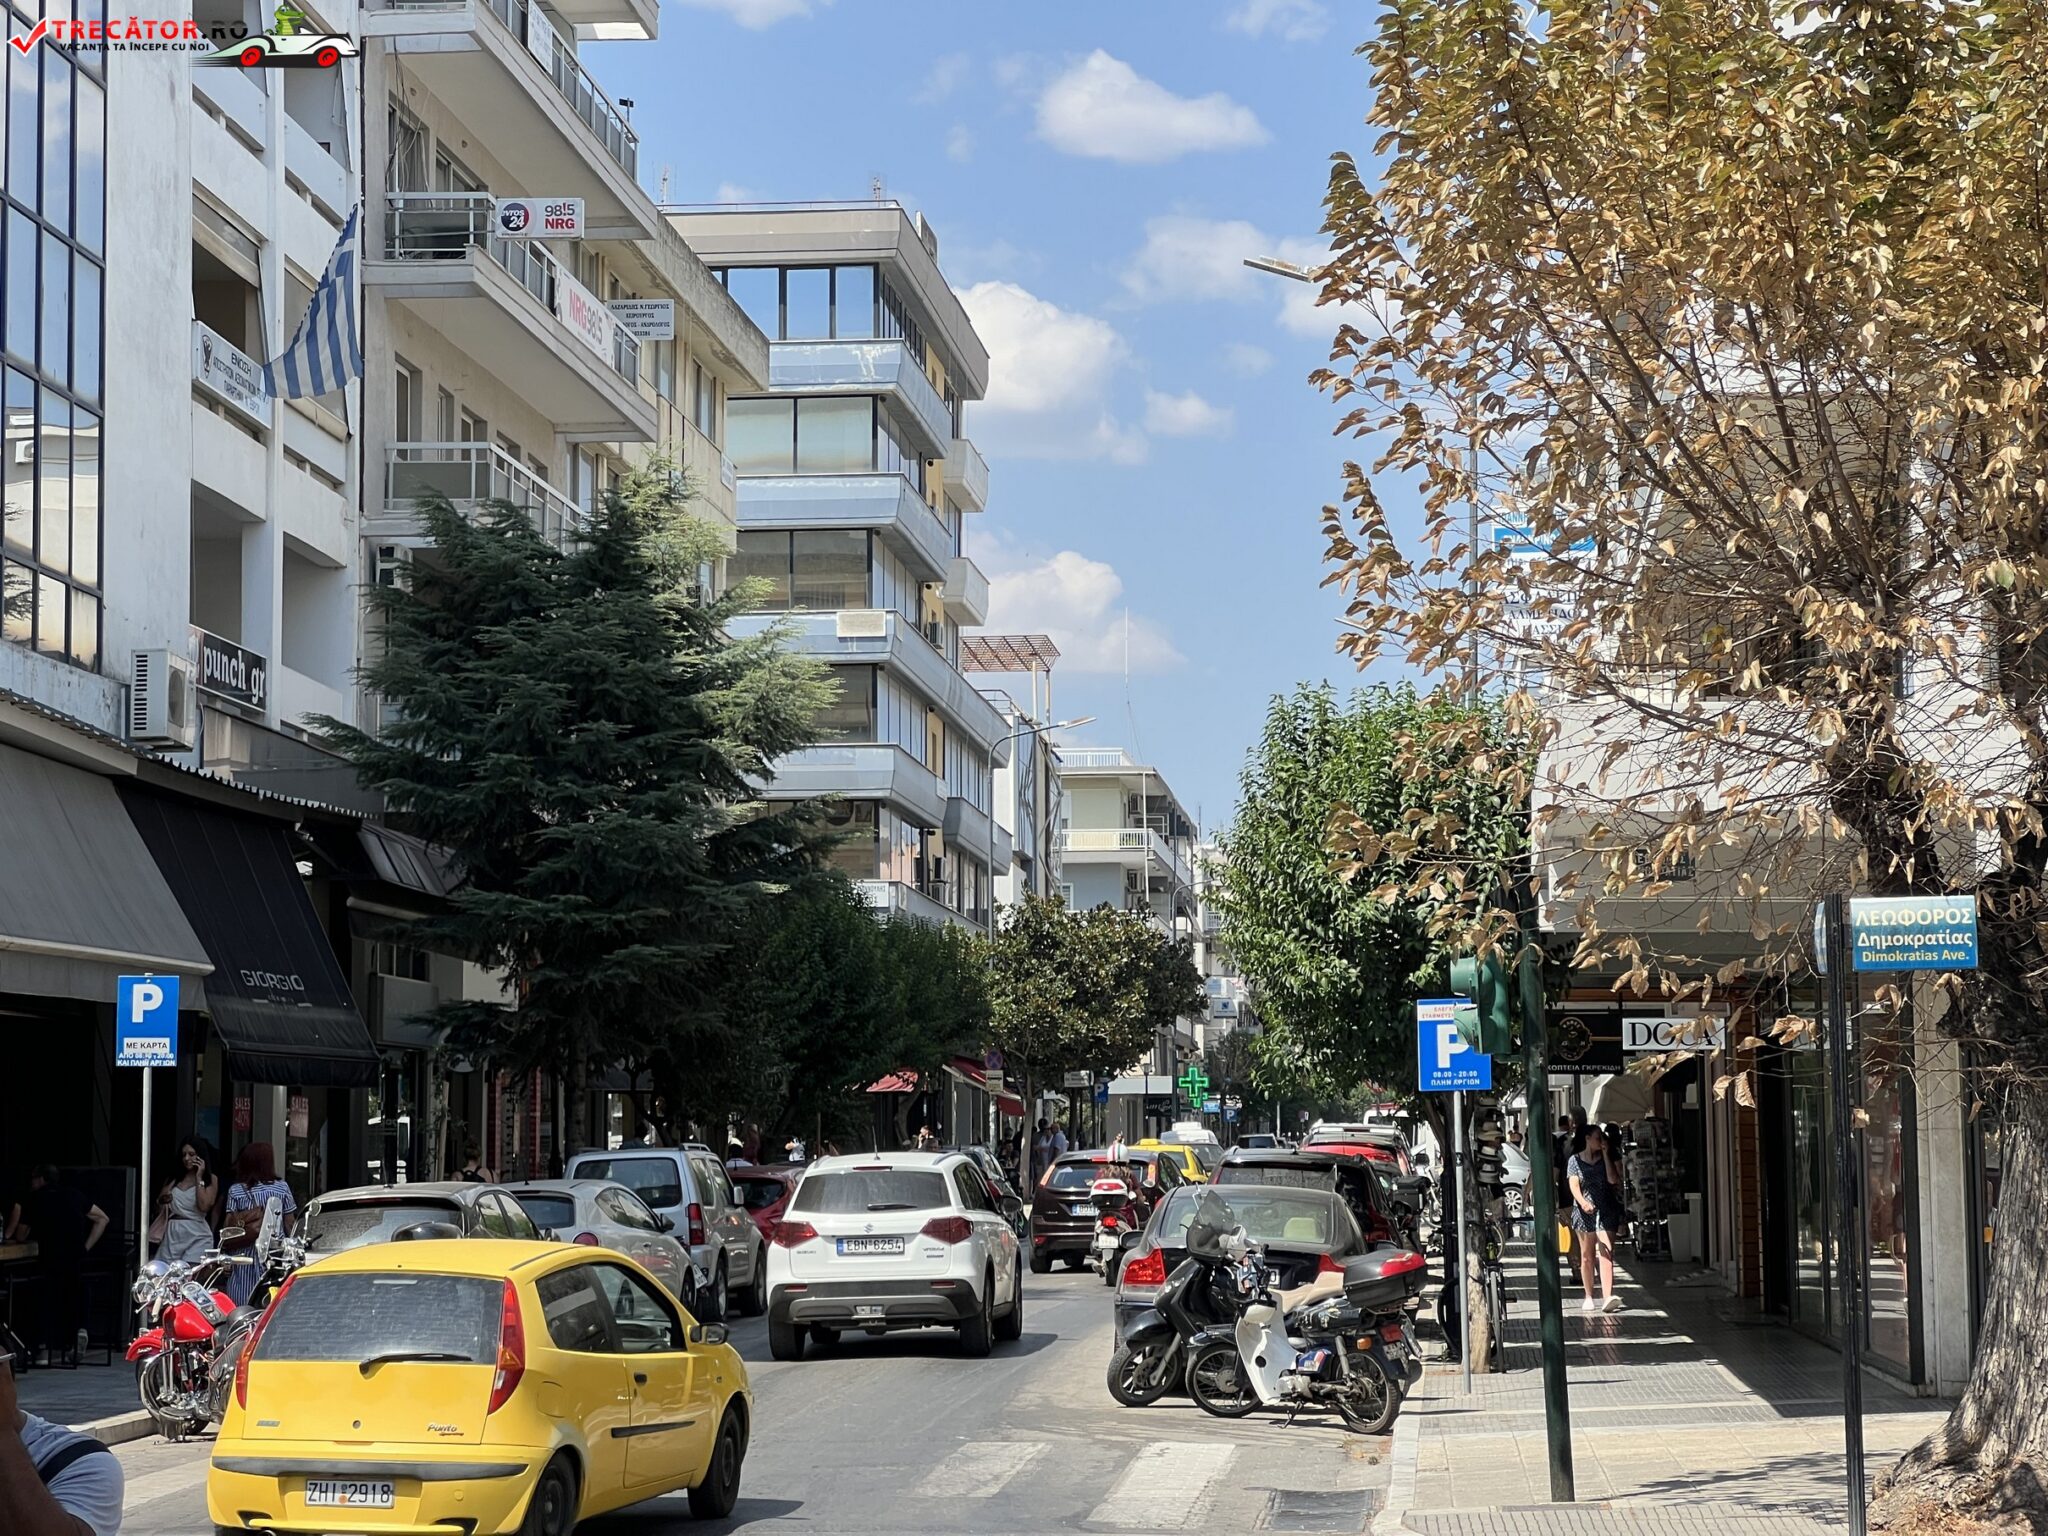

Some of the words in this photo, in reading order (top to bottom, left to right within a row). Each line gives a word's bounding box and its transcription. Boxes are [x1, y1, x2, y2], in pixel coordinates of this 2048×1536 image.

[509, 216, 525, 228] 24
[545, 218, 575, 229] NRG
[203, 646, 246, 690] punch
[1856, 908, 1973, 926] ΛΕΩΦΟΡΟΣ
[1857, 929, 1973, 949] Δημοκρατίας
[1862, 950, 1938, 962] Dimokratias
[1942, 949, 1970, 960] Ave.
[240, 969, 305, 991] GIORGIO
[131, 983, 164, 1023] P
[1436, 1023, 1470, 1069] P
[1226, 1110, 1235, 1120] P
[846, 1239, 868, 1251] EBN
[873, 1239, 901, 1251] 6254
[427, 1423, 458, 1432] Punto
[308, 1482, 337, 1503] ZHI
[347, 1483, 391, 1504] 2918
